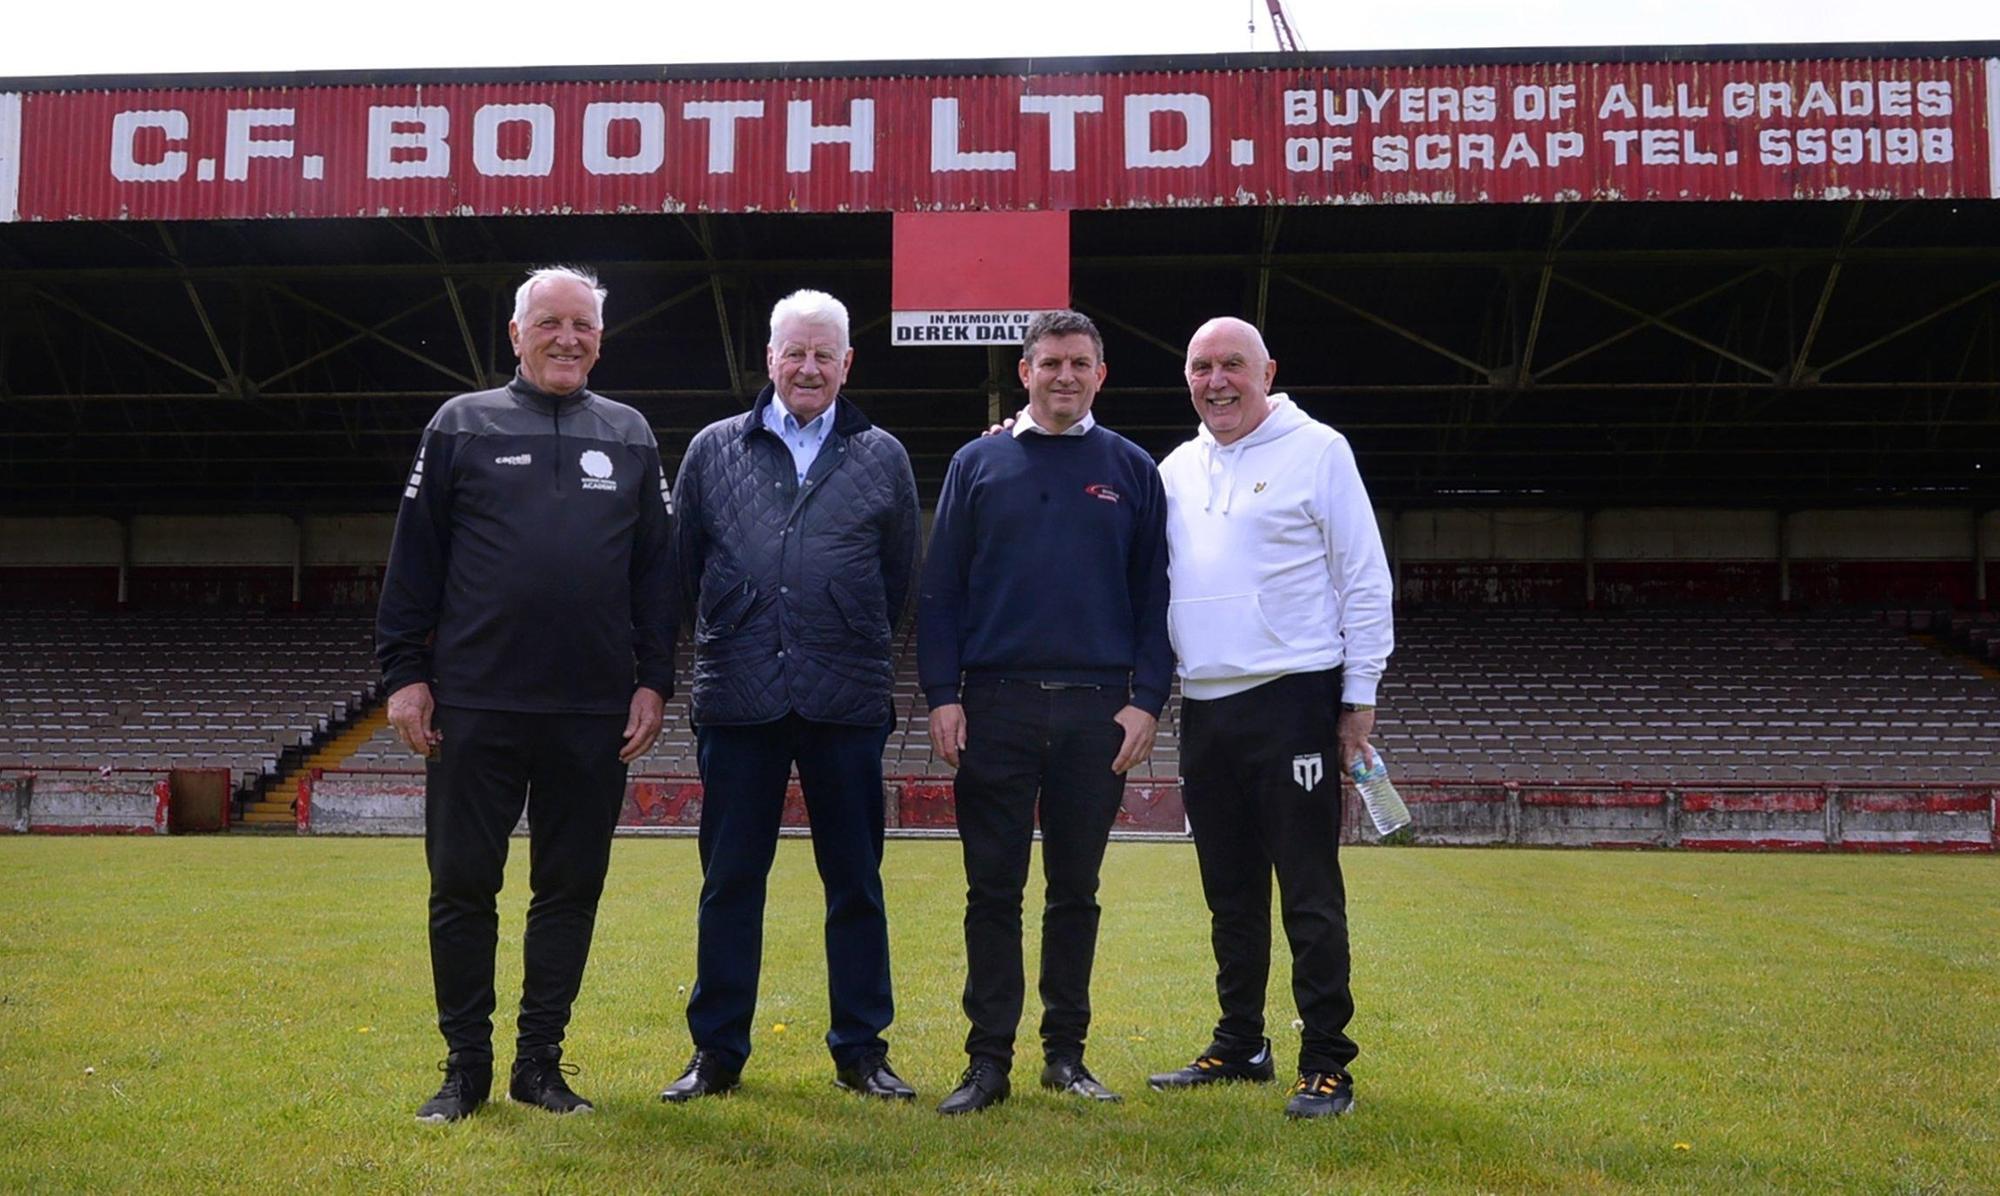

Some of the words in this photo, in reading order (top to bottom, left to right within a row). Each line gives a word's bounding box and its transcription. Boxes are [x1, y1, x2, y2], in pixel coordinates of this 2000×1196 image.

[1284, 86, 1497, 126] BUYERS
[1513, 85, 1579, 121] OF
[1598, 82, 1709, 119] ALL
[1723, 80, 1953, 119] GRADES
[111, 108, 323, 182] C.F.
[367, 99, 874, 180] BOOTH
[931, 93, 1254, 173] LTD.
[1285, 136, 1353, 173] OF
[1372, 131, 1584, 172] SCRAP
[1603, 129, 1738, 166] TEL.
[1759, 127, 1954, 166] 559198
[896, 326, 970, 341] DEREK
[976, 325, 1030, 340] DALT
[930, 315, 944, 324] IN
[948, 314, 1009, 324] MEMORY
[1013, 314, 1030, 323] OF
